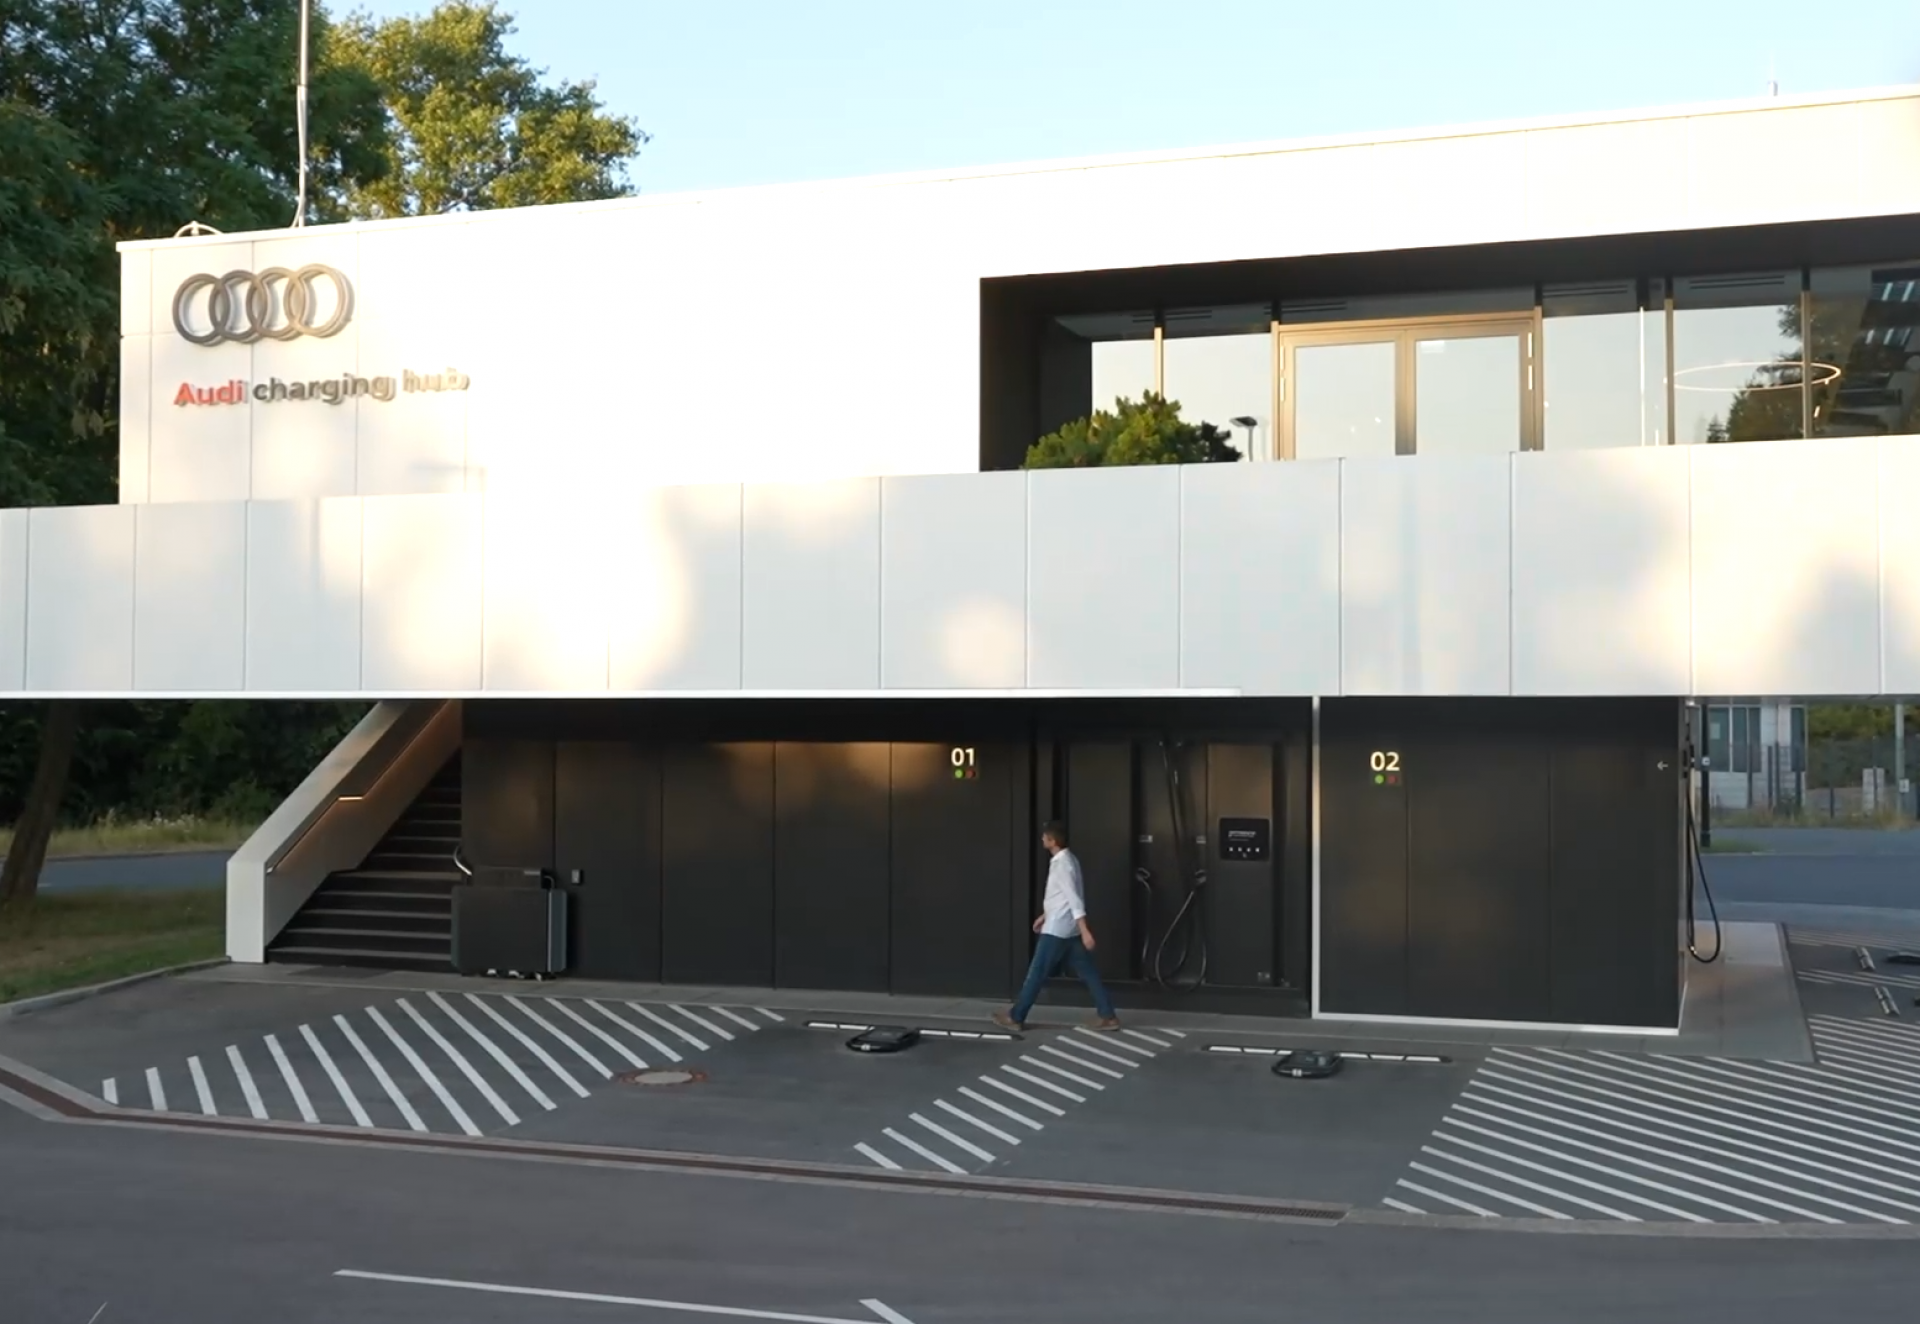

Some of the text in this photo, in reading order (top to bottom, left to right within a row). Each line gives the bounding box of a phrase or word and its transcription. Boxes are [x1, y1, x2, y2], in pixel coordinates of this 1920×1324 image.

[173, 367, 470, 406] Audi charging hub
[950, 747, 975, 766] 01
[1370, 751, 1400, 771] 02
